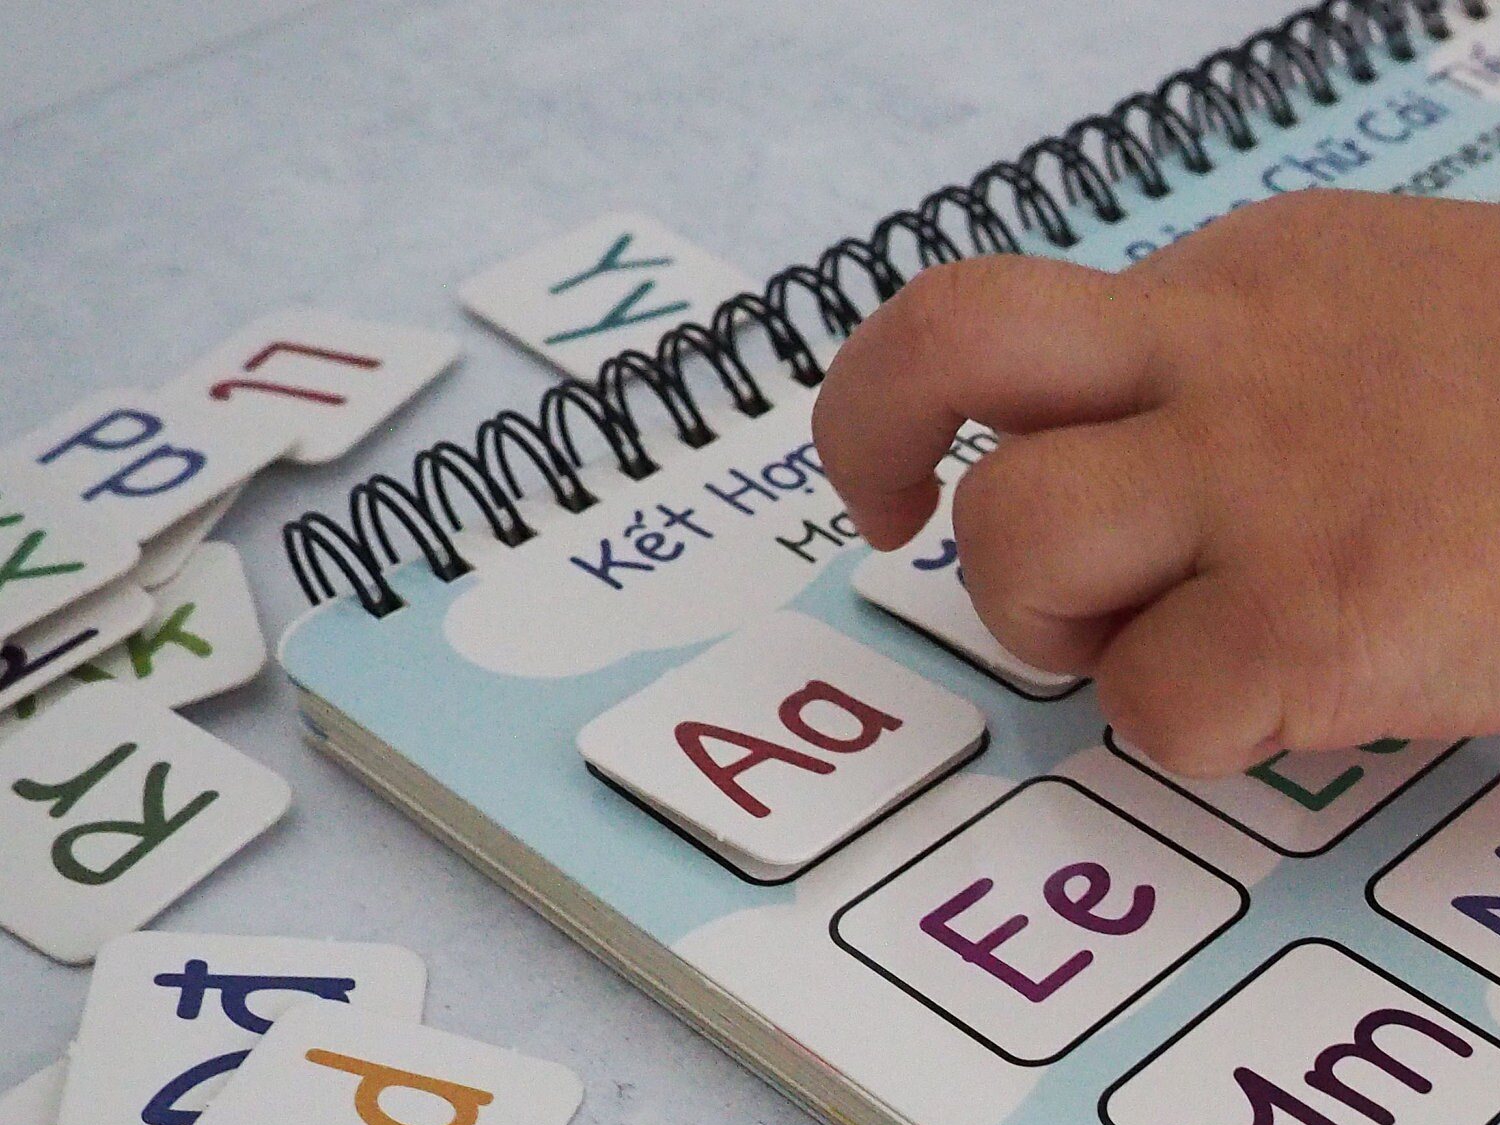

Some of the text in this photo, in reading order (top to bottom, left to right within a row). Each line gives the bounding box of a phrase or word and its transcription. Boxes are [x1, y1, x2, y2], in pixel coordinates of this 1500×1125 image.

[544, 232, 693, 344] Yy
[569, 507, 713, 590] Kết
[12, 741, 220, 886] Rr
[675, 679, 903, 818] Aa
[920, 861, 1157, 1004] Ee
